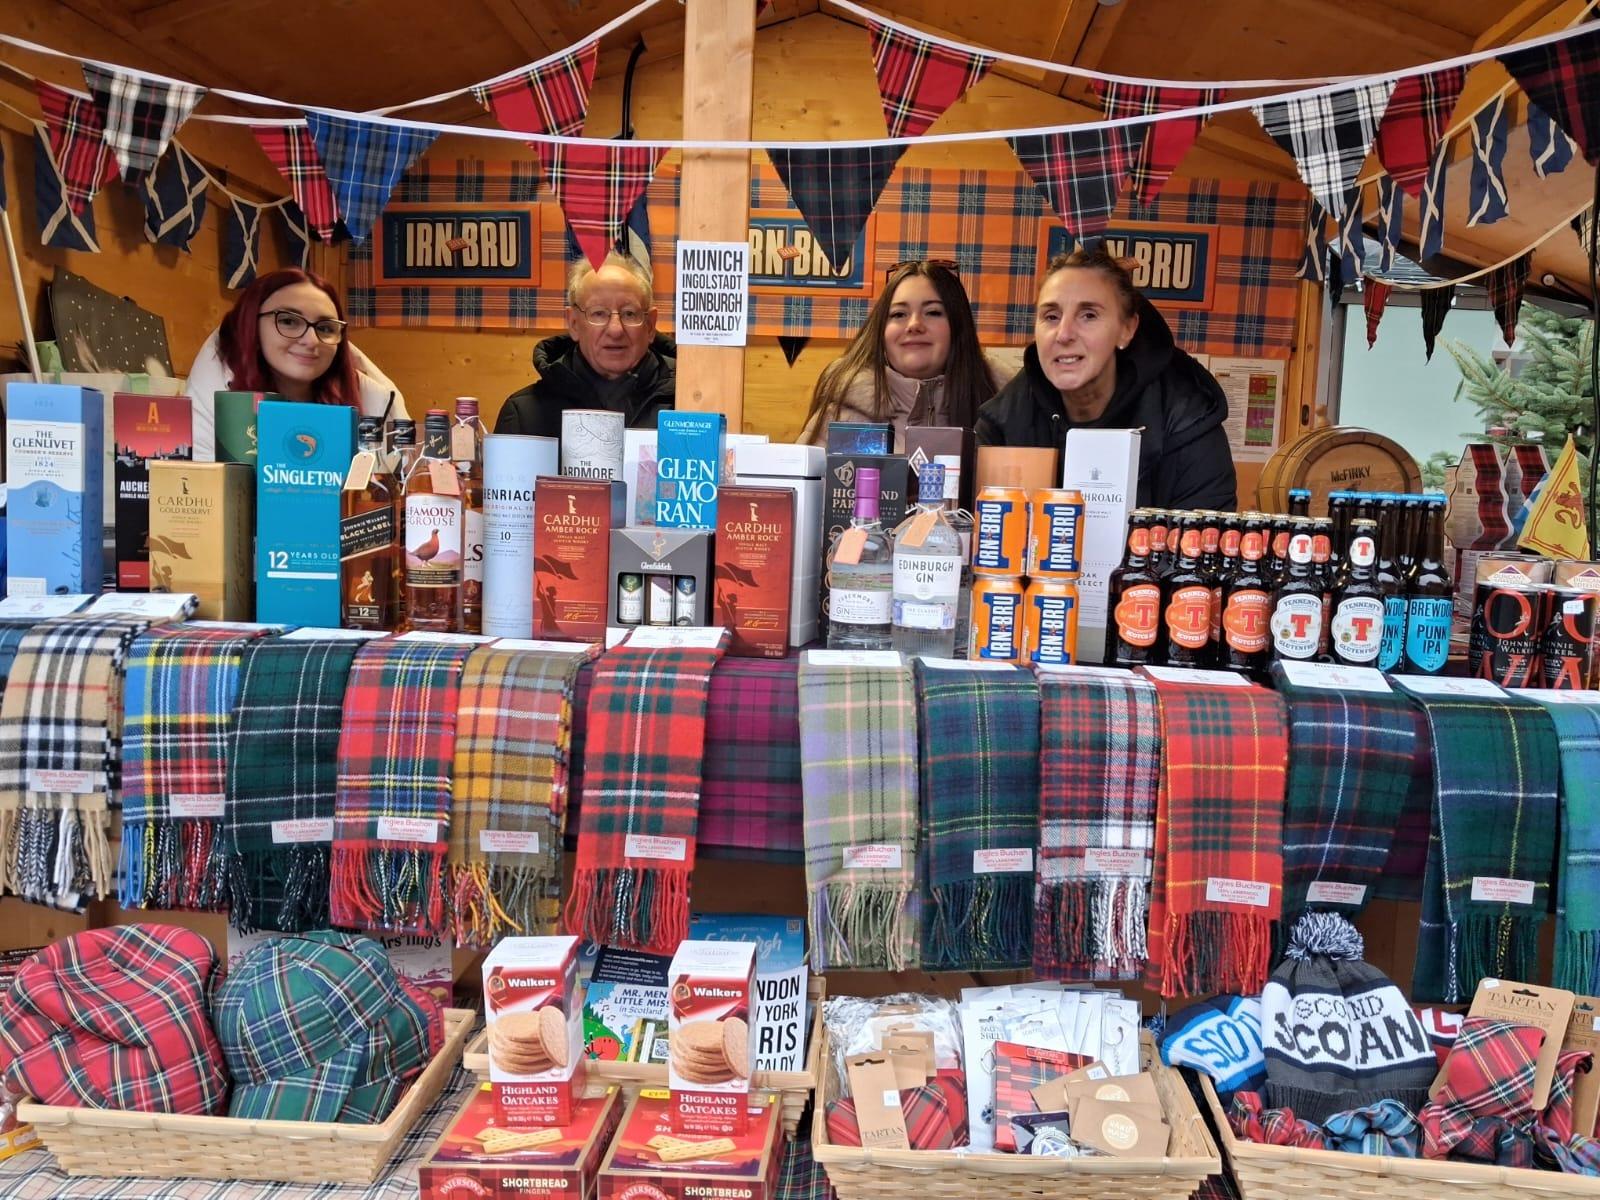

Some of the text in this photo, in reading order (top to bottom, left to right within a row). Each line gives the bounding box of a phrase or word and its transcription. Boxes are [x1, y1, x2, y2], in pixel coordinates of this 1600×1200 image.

[682, 249, 743, 272] MUNICH
[682, 273, 742, 290] INGOLSTADT
[681, 291, 742, 313] EDINBURGH
[681, 314, 742, 331] KIRKCALDY
[663, 420, 712, 429] GLENMORANGIE
[36, 430, 53, 438] THE
[12, 437, 76, 450] GLENLIVET
[263, 464, 342, 486] SINGLETON
[564, 467, 614, 480] ARDMORE
[658, 457, 715, 481] GLEN
[1330, 465, 1371, 483] McFINKY
[677, 481, 717, 503] MO
[157, 496, 213, 508] CARDHU
[409, 507, 455, 517] FAMOUS
[656, 501, 703, 524] RAN
[410, 517, 455, 526] GROUSE
[543, 514, 600, 526] CARDHU
[340, 530, 366, 541] BLACK
[367, 522, 391, 533] LABEL
[725, 522, 782, 534] CARDHU
[500, 531, 511, 540] 10
[1297, 539, 1309, 553] T
[1358, 542, 1370, 556] T
[268, 551, 338, 569] 12 YEARS OLD
[899, 560, 954, 572] EDINBURGH
[916, 573, 934, 583] GIN
[359, 607, 369, 616] 12
[836, 607, 850, 616] GIN
[1135, 604, 1154, 628] T
[1186, 605, 1204, 629] T
[1241, 609, 1261, 633] T
[1290, 614, 1311, 637] T
[1352, 617, 1373, 641] T
[1417, 624, 1448, 640] PUNK
[1231, 636, 1256, 646] SCOTCH
[1423, 640, 1441, 655] IPA
[35, 771, 57, 779] Ingles
[276, 823, 298, 831] Ingles
[383, 819, 404, 827] Ingles
[1000, 849, 1028, 857] Buchan
[1212, 880, 1265, 890] Ingles Buchan
[1476, 879, 1529, 888] Ingles Buchan
[508, 978, 556, 988] Walkers
[622, 989, 667, 999] MR. MEN
[693, 987, 742, 998] Walkers
[614, 997, 643, 1006] LITTLE
[1488, 991, 1557, 1011] TARTAN
[628, 1006, 662, 1015] Scotland
[765, 1001, 798, 1022] YORK
[502, 1086, 557, 1094] HIGHLAND
[502, 1096, 558, 1105] OATCAKES
[680, 1094, 736, 1105] HIGHLAND
[680, 1104, 737, 1115] OATCAKES
[863, 1127, 905, 1138] TARTAN
[439, 1177, 486, 1196] PATERSON'S
[502, 1178, 568, 1188] SHORTBREAD
[685, 1187, 752, 1198] SHORTBREAD
